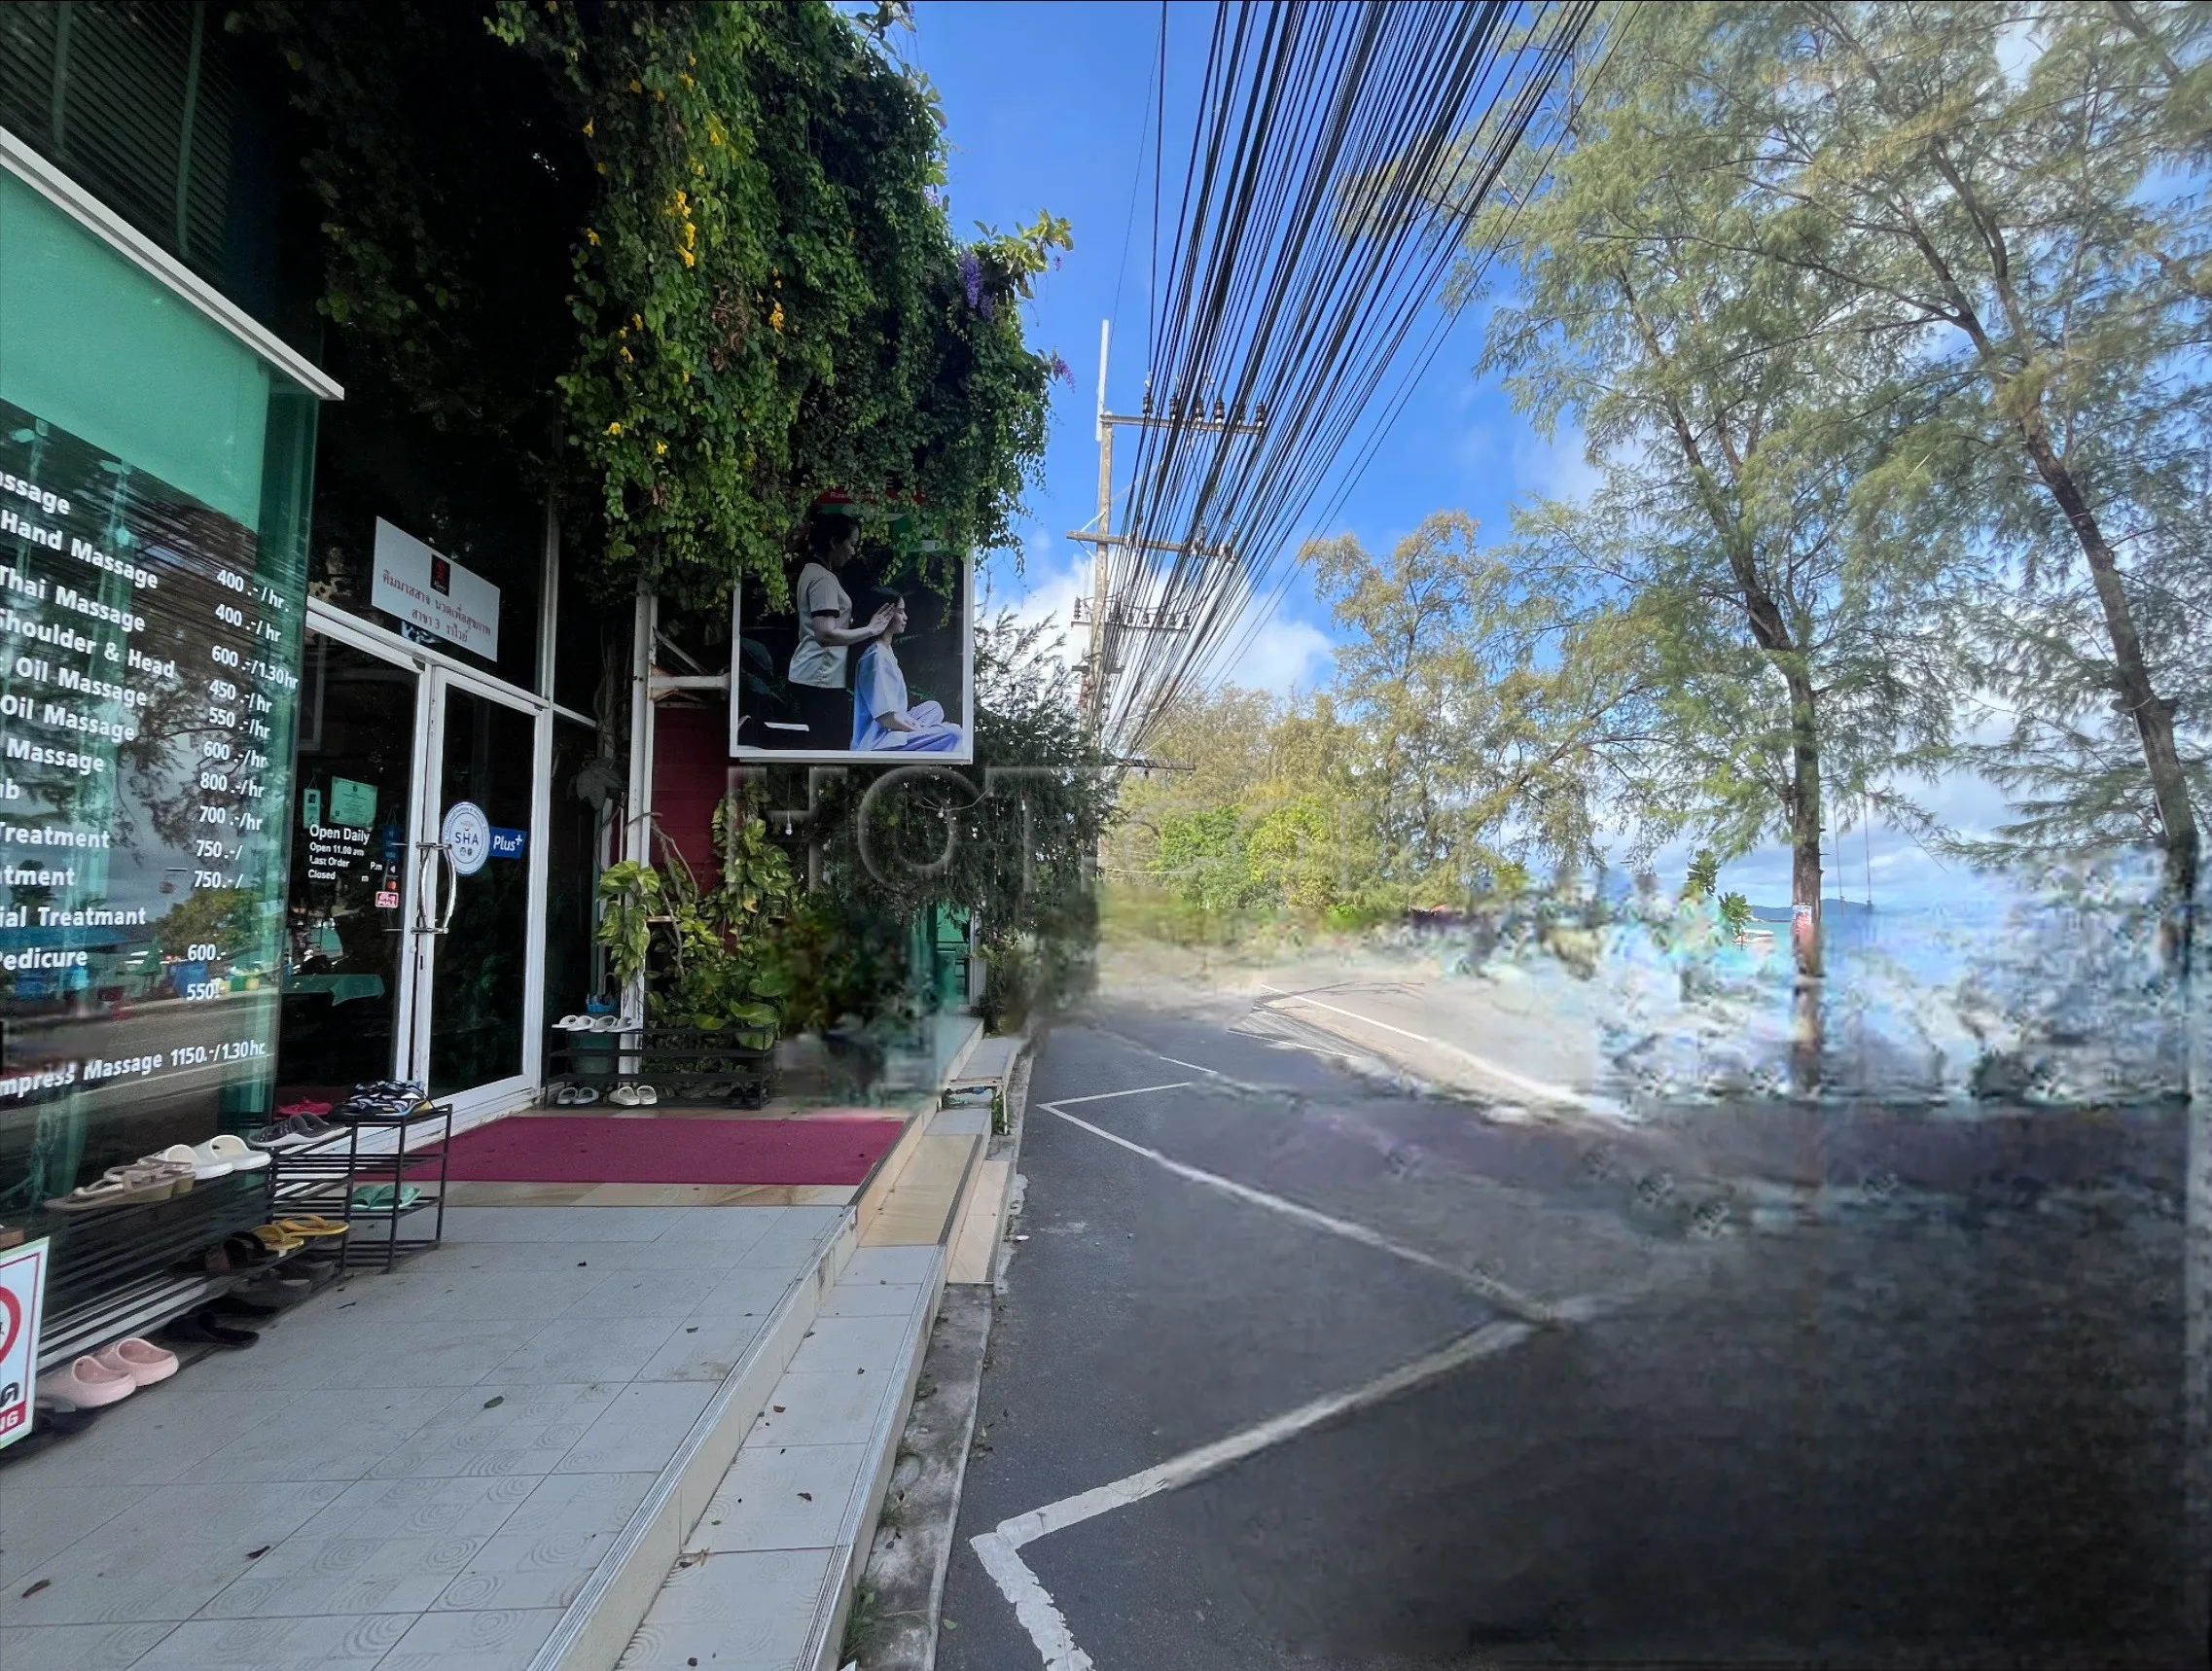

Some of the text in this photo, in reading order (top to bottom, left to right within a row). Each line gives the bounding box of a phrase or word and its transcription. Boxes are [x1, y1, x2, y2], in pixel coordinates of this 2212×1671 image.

[1, 509, 63, 551] Hand
[71, 537, 159, 589] Massage
[215, 603, 242, 626] 400
[217, 569, 244, 592] 400
[55, 585, 146, 632] Massage
[211, 645, 239, 668] 600
[104, 641, 120, 662] &
[127, 648, 176, 678] Head
[209, 678, 236, 701] 450
[16, 657, 49, 682] Oil
[57, 667, 147, 708] Massage
[208, 707, 235, 729] 550
[0, 694, 34, 720] Oil
[43, 703, 135, 743] Massage
[203, 741, 231, 762] 600
[6, 737, 105, 775] Massage
[199, 772, 228, 792] 800
[198, 806, 227, 824] 700
[309, 823, 340, 840] Open
[343, 828, 370, 845] Daily
[454, 831, 480, 846] SHA
[309, 841, 331, 854] Open
[333, 844, 352, 856] 11.00
[309, 855, 327, 866] Last
[328, 857, 350, 868] Order
[307, 870, 336, 880] Closed
[38, 907, 146, 927] Treatmant
[83, 1053, 162, 1082] Massage
